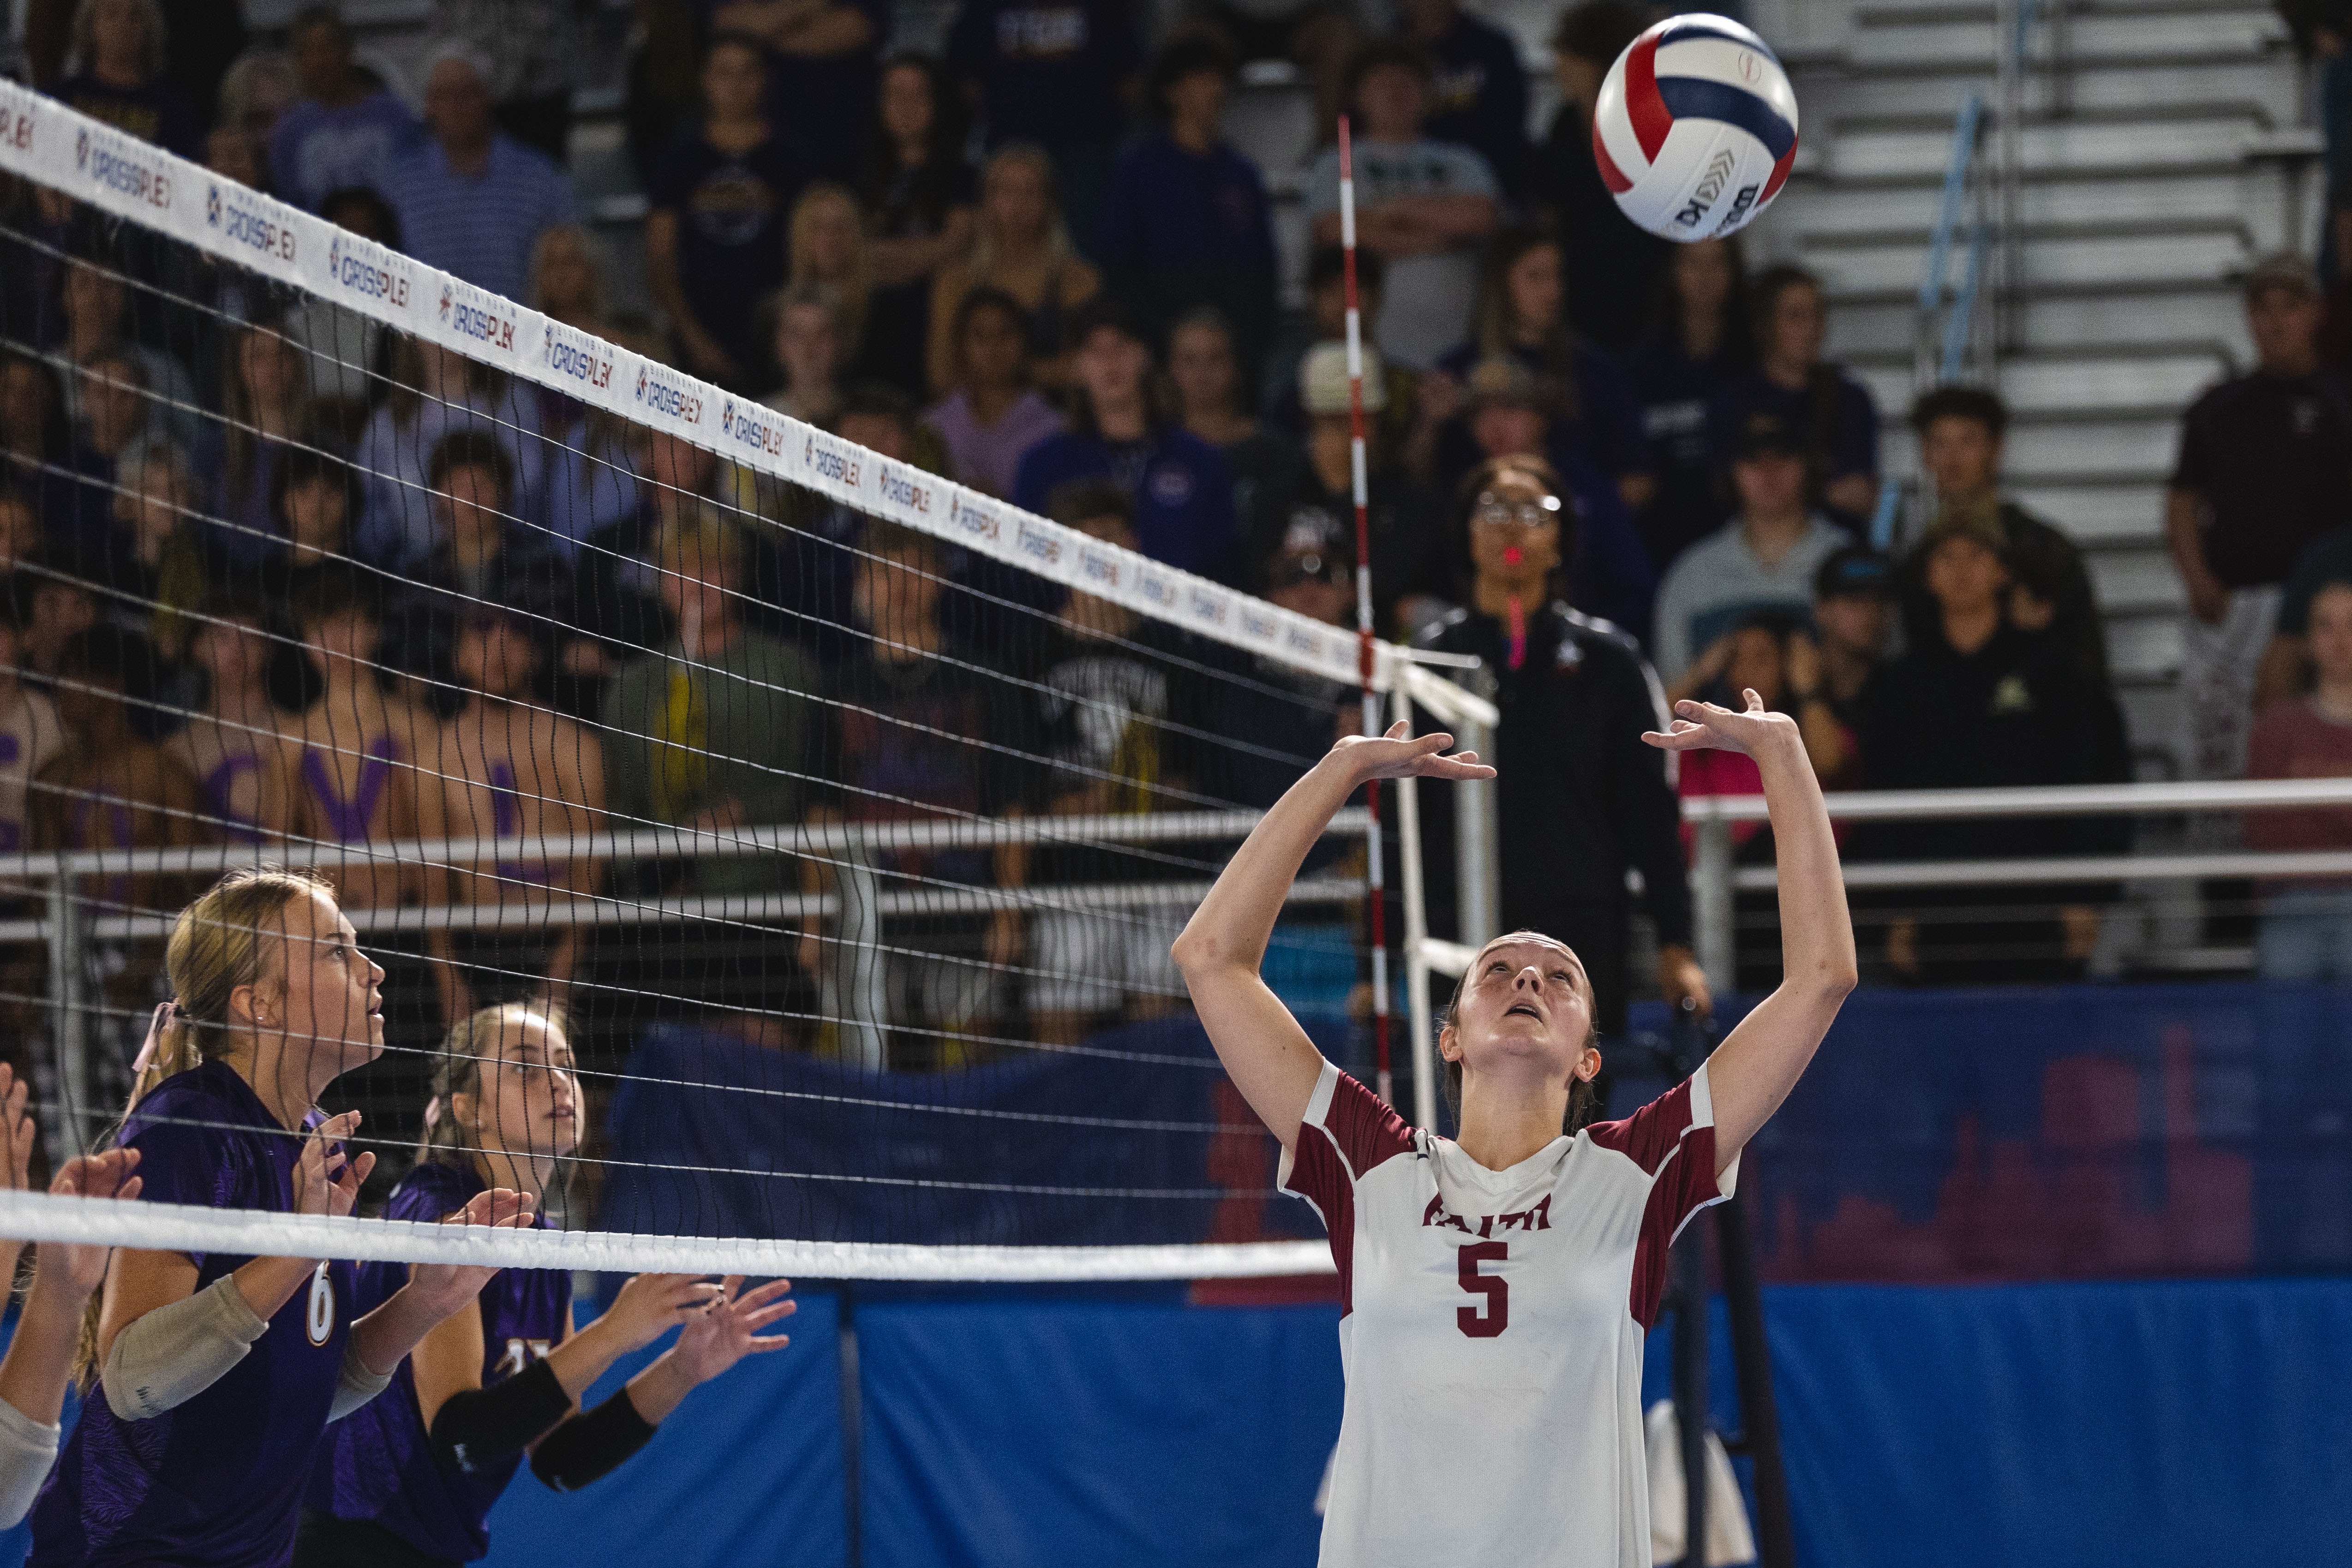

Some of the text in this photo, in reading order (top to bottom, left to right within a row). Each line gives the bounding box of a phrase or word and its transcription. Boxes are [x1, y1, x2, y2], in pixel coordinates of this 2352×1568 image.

[302, 736, 401, 841] V
[305, 1259, 337, 1349] 6
[1457, 1241, 1509, 1338] 5
